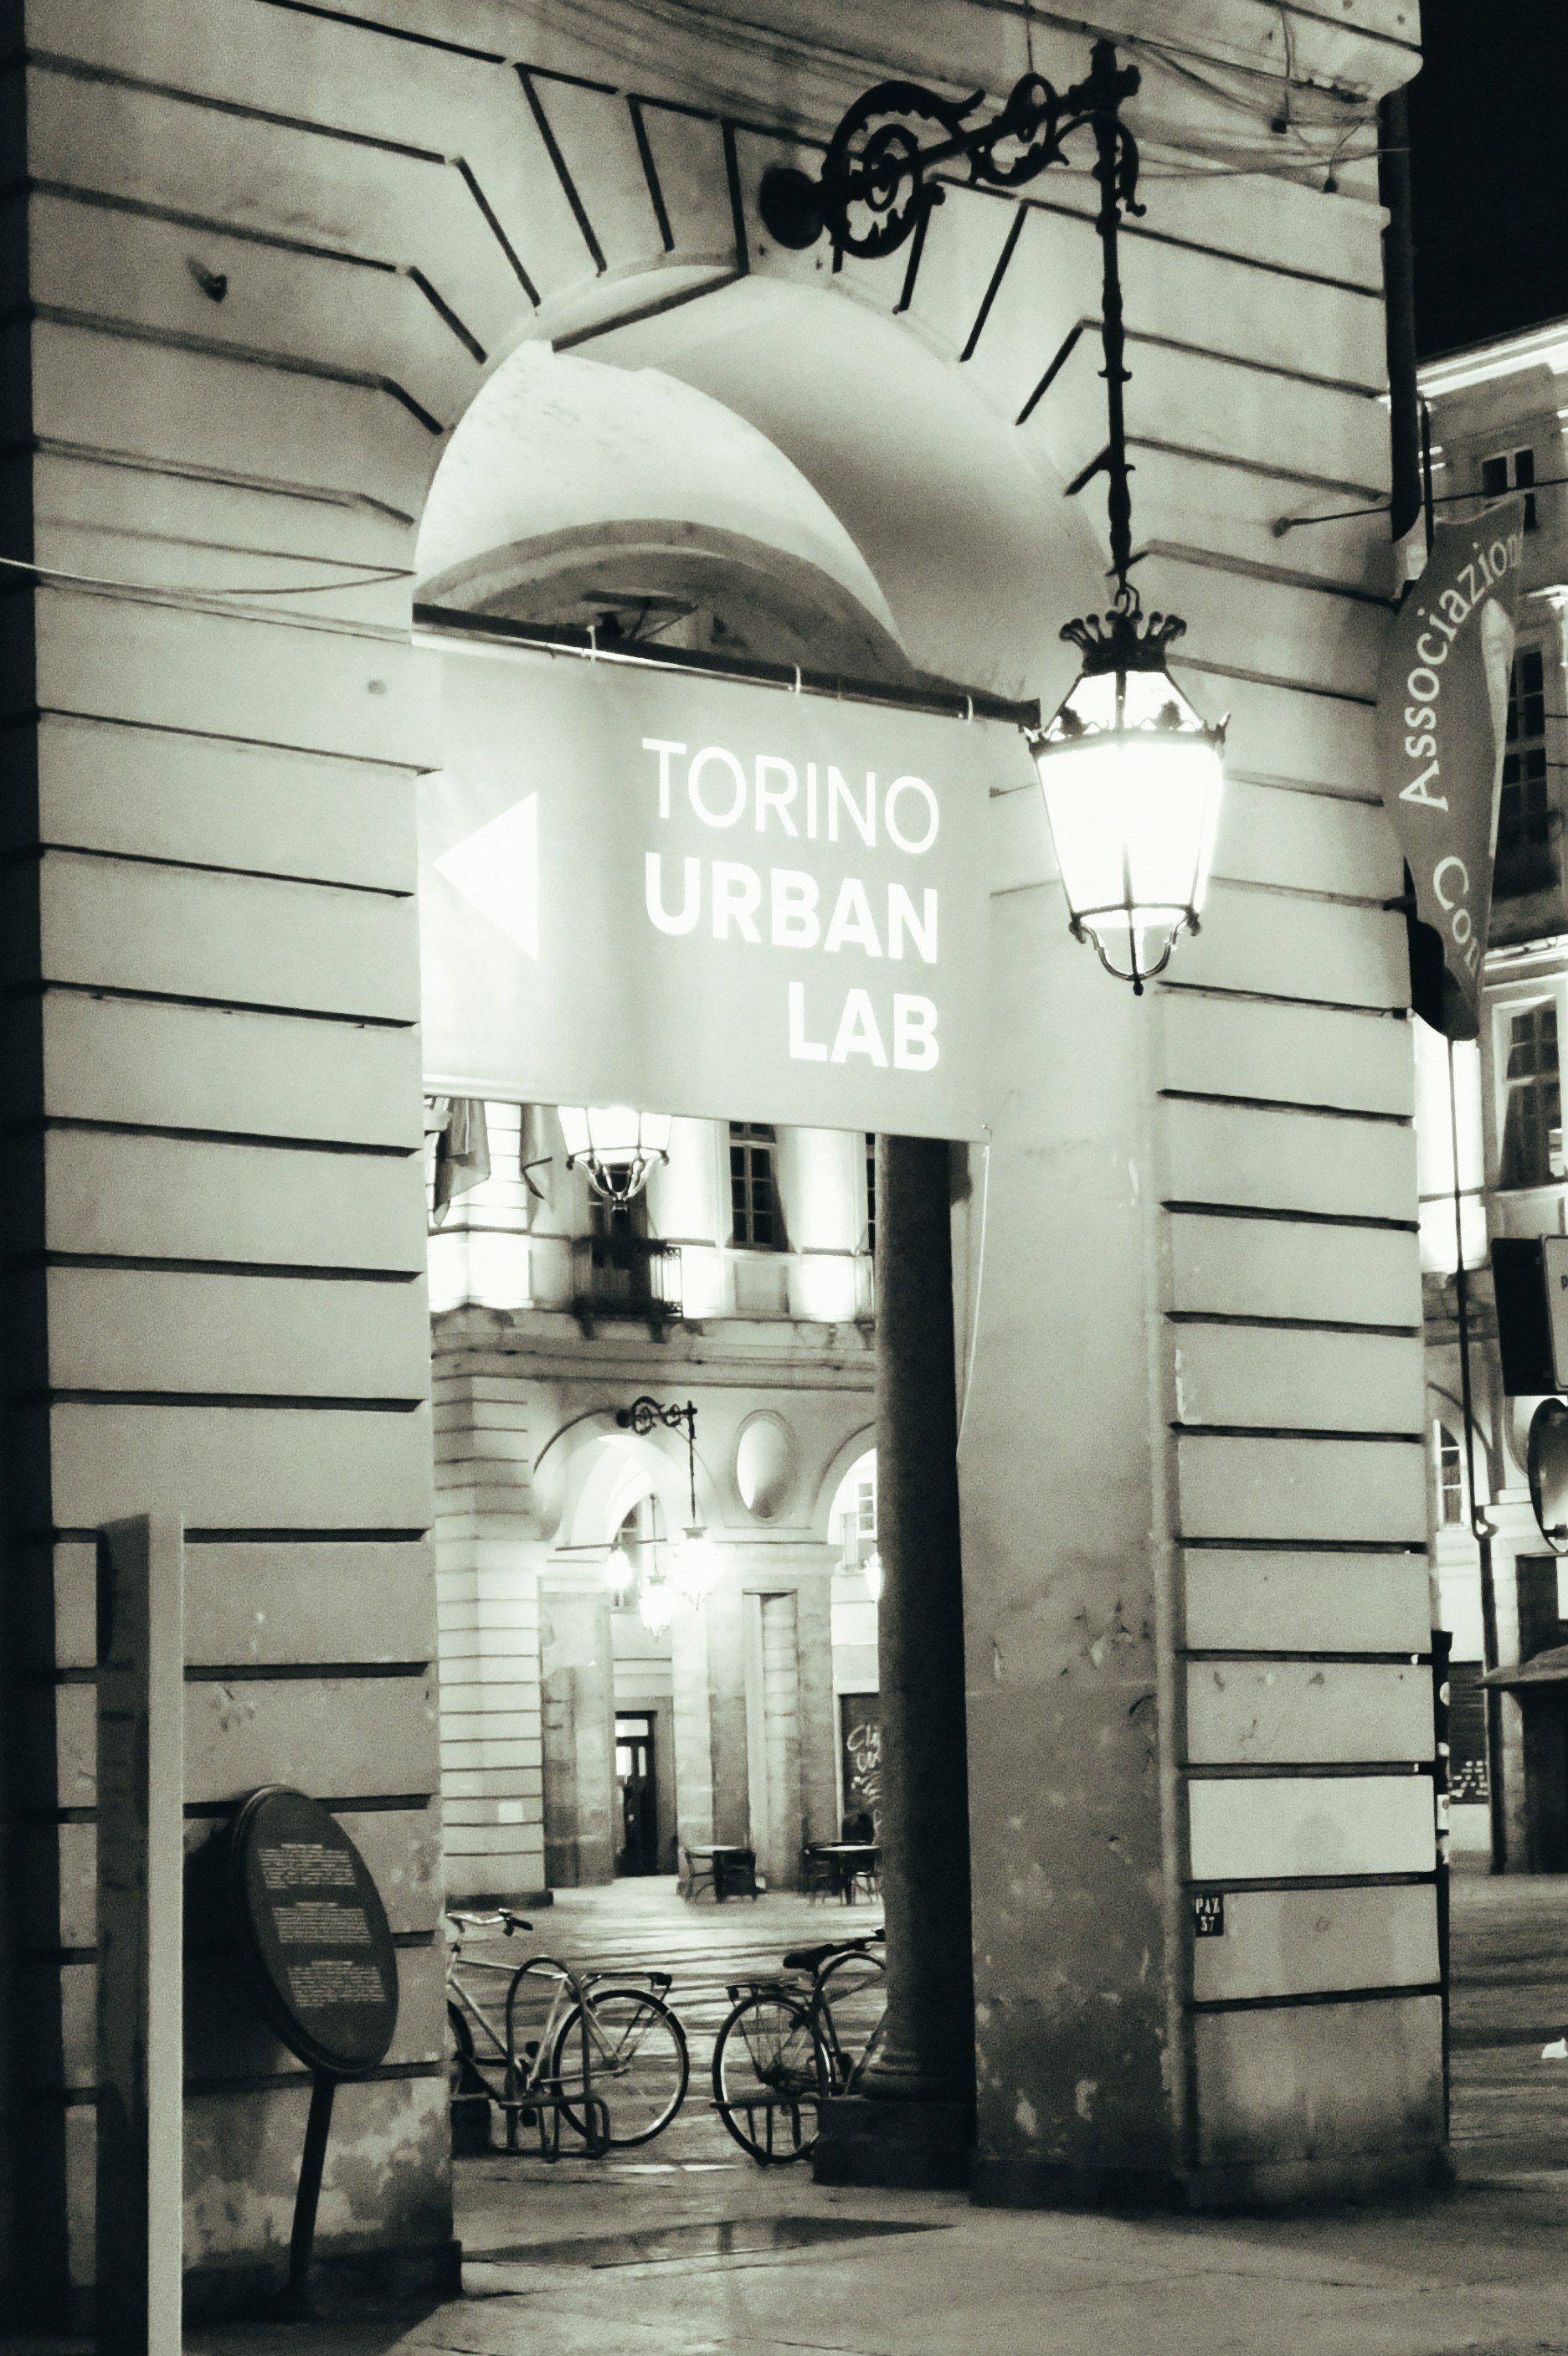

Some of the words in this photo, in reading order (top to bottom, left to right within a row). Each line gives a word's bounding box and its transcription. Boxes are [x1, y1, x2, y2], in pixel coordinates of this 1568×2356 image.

[642, 738, 939, 854] TORINO
[645, 852, 938, 964] URBAN
[789, 981, 939, 1072] LAB
